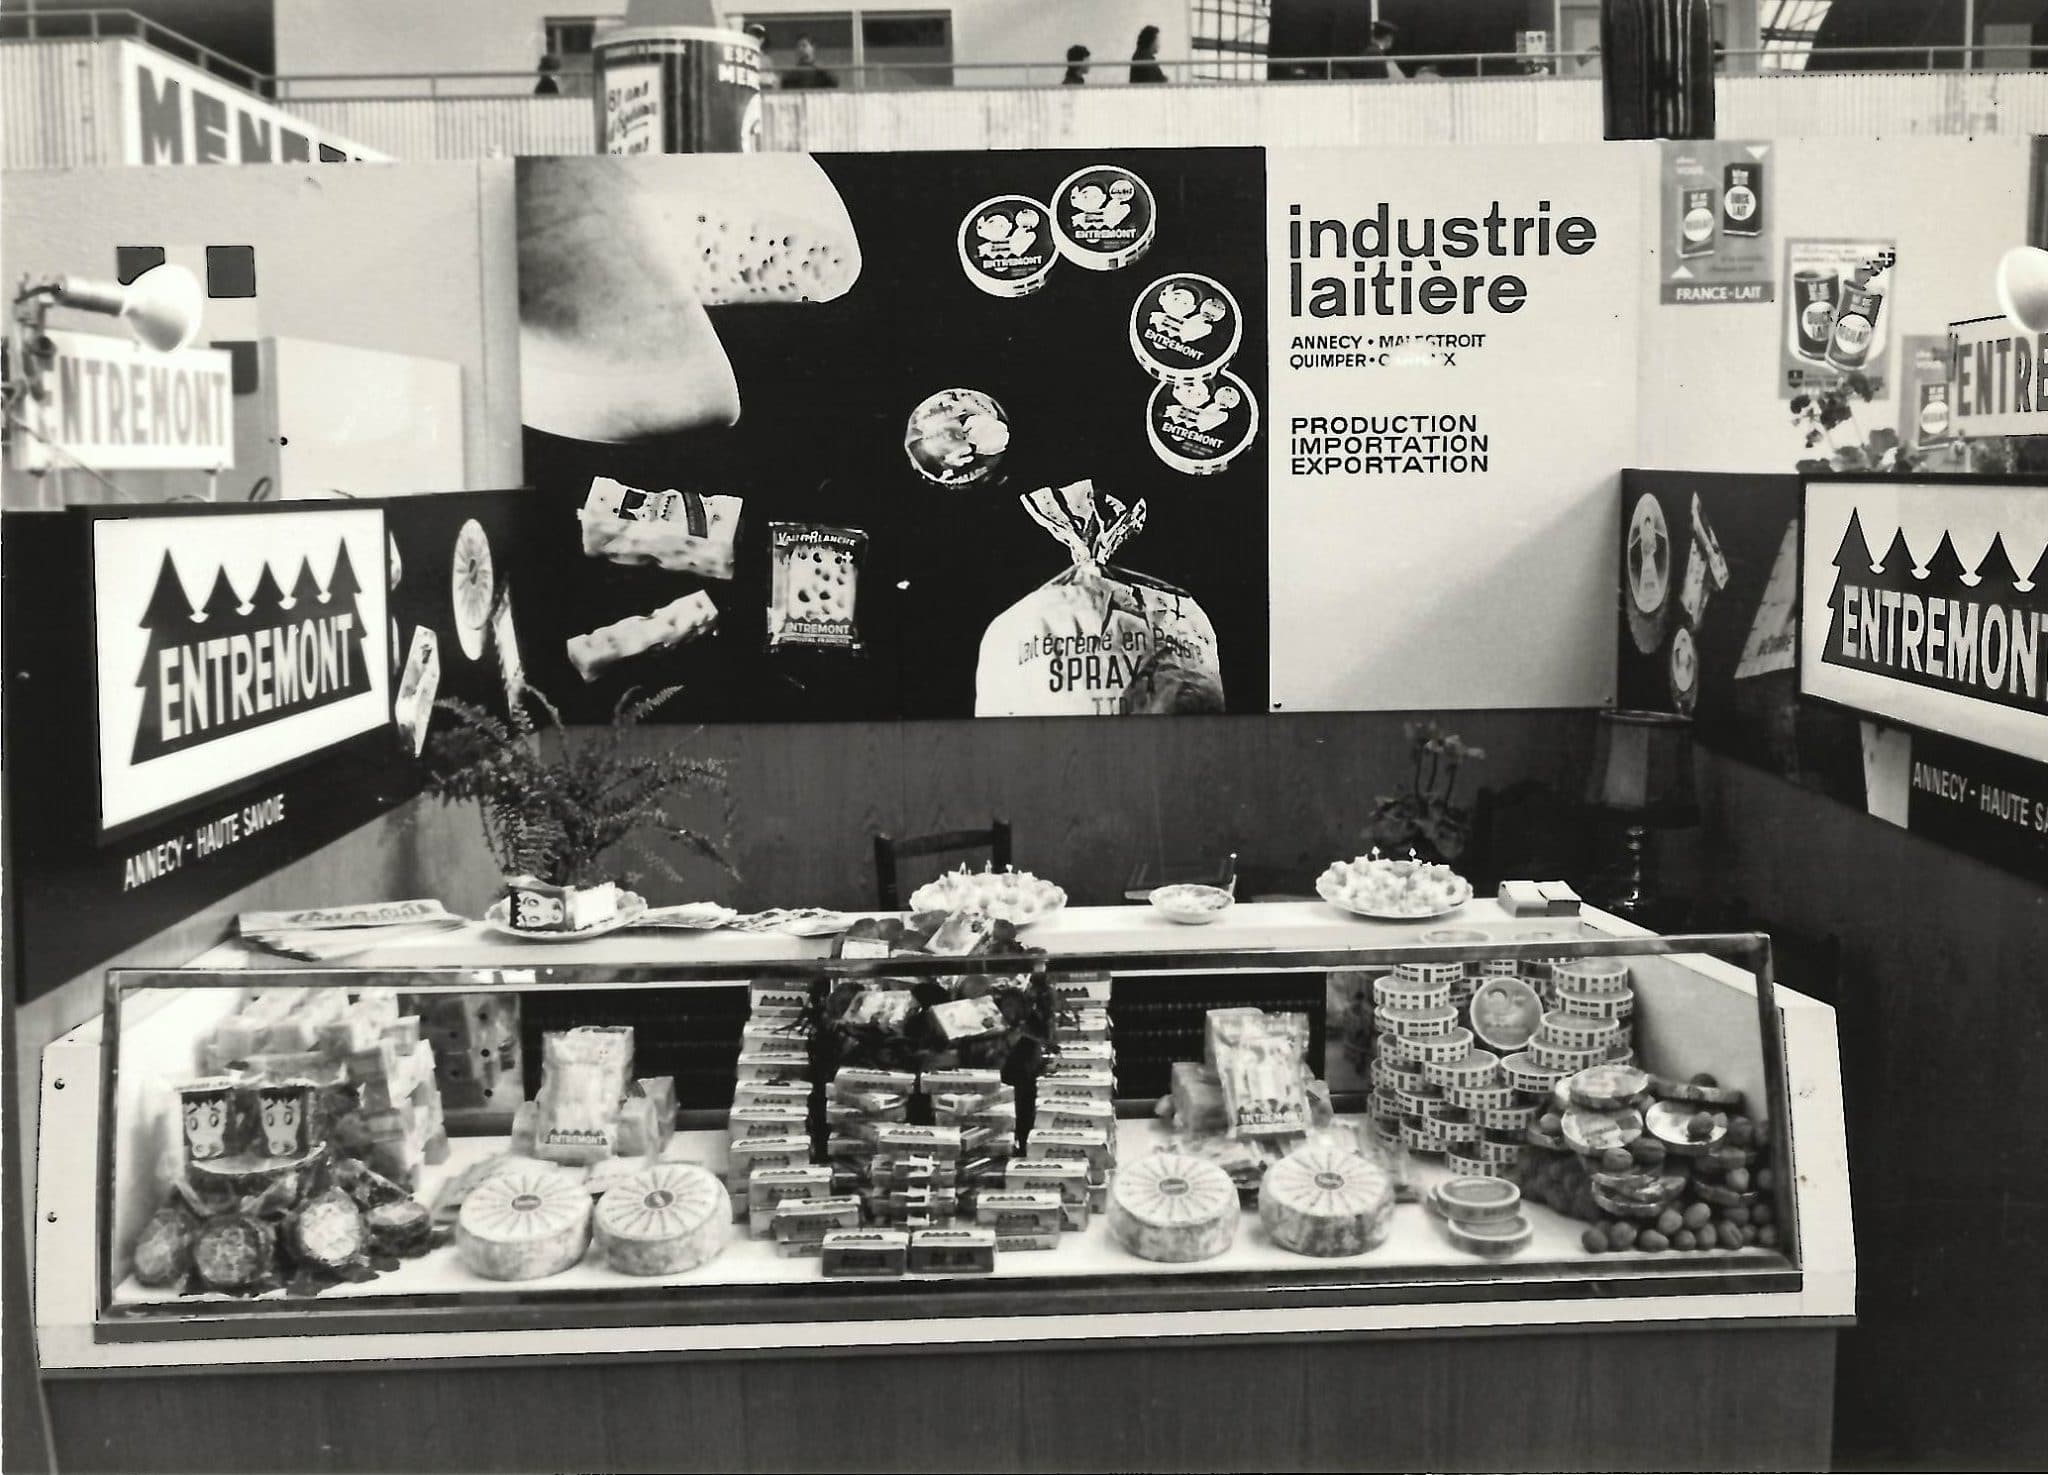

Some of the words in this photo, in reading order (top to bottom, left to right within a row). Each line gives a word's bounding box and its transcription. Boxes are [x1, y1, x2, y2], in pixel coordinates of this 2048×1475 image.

[1075, 228, 1137, 239] ENTREMONT
[1290, 200, 1597, 259] industrie
[983, 255, 1042, 269] ENTREMONT
[1290, 260, 1528, 319] laitière
[1144, 328, 1205, 361] ENTREMONT
[1291, 335, 1363, 349] ANNECY
[1379, 334, 1487, 349] MASTROIT
[1290, 353, 1366, 370] QUIMPER
[1161, 421, 1225, 449] ENTREMONT
[1291, 414, 1477, 434] PRODUCTION
[1291, 434, 1488, 455] IMPORTATION
[1291, 455, 1488, 475] EXPORTATION
[784, 622, 850, 635] ENTREMONT
[1123, 631, 1147, 651] en
[1842, 584, 2048, 703] ENTREMON
[158, 612, 353, 743] ENTREMONT
[1050, 655, 1144, 692] SPRAY
[1913, 761, 1968, 804] ANNECY
[1980, 783, 2030, 827] HAUTE
[123, 835, 185, 892] ANNECY
[196, 812, 241, 858] HAUTE
[242, 793, 286, 836] SAVOIE
